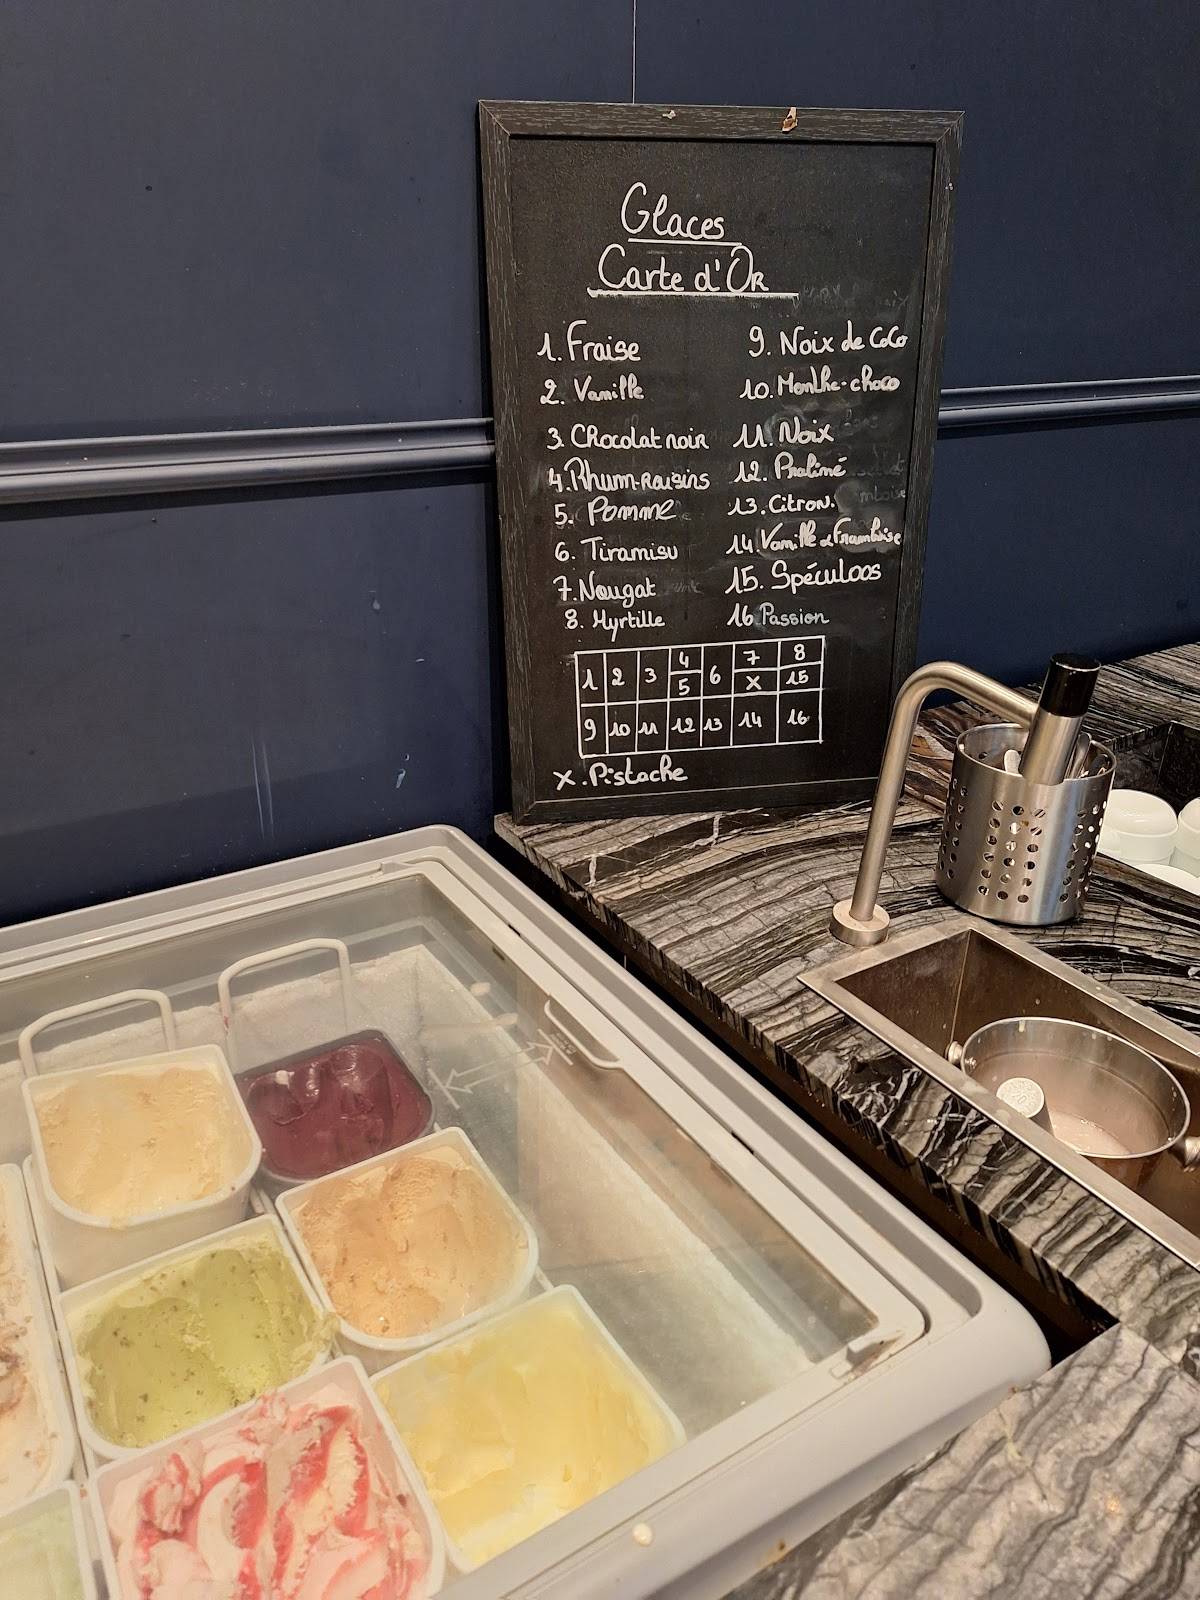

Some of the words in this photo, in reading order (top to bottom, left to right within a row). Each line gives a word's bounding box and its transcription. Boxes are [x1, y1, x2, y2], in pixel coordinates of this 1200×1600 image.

[621, 182, 724, 240] Glaces
[598, 243, 684, 291] Carte
[537, 332, 563, 361] 1.
[567, 320, 641, 361] Fraise
[749, 325, 771, 357] 9.
[779, 326, 834, 355] Noix
[841, 320, 865, 352] de
[540, 379, 565, 404] 2.
[574, 373, 644, 401] Vanille
[739, 379, 774, 400] 10.
[547, 427, 565, 450] 3.
[571, 423, 662, 449] Chocolat
[733, 423, 774, 448] 11.
[778, 416, 834, 444] Noix
[548, 467, 570, 493] 4.
[734, 460, 768, 483] 12.
[774, 451, 847, 480] Praliné
[555, 503, 574, 526] 5.
[587, 495, 677, 527] Pomme
[728, 497, 766, 516] 13.
[554, 541, 576, 562] 6.
[580, 536, 679, 562] Tiramisu
[726, 533, 760, 554] 14.
[761, 519, 817, 551] Vanille
[833, 516, 902, 546] Framboise
[552, 575, 577, 602] 7.
[578, 570, 657, 608] Nougat
[725, 565, 764, 594] 15.
[771, 558, 882, 594] Spéculoos
[564, 608, 584, 630] 8.
[592, 609, 666, 642] Myrtille
[758, 601, 830, 627] Passion
[581, 668, 599, 690] 1
[611, 667, 625, 686] 2
[644, 667, 657, 683] 3
[678, 651, 690, 668] 4
[708, 665, 722, 684] 6
[743, 650, 761, 665] 7
[793, 643, 806, 660] 8
[678, 677, 690, 696] 5
[786, 673, 809, 685] 15
[584, 718, 597, 741] 9
[609, 721, 631, 737] 10
[638, 721, 659, 735] 11
[670, 716, 696, 734] 12
[703, 716, 724, 732] 13
[738, 711, 763, 728] 14
[787, 708, 808, 725] 16
[588, 754, 689, 787] Pistache
